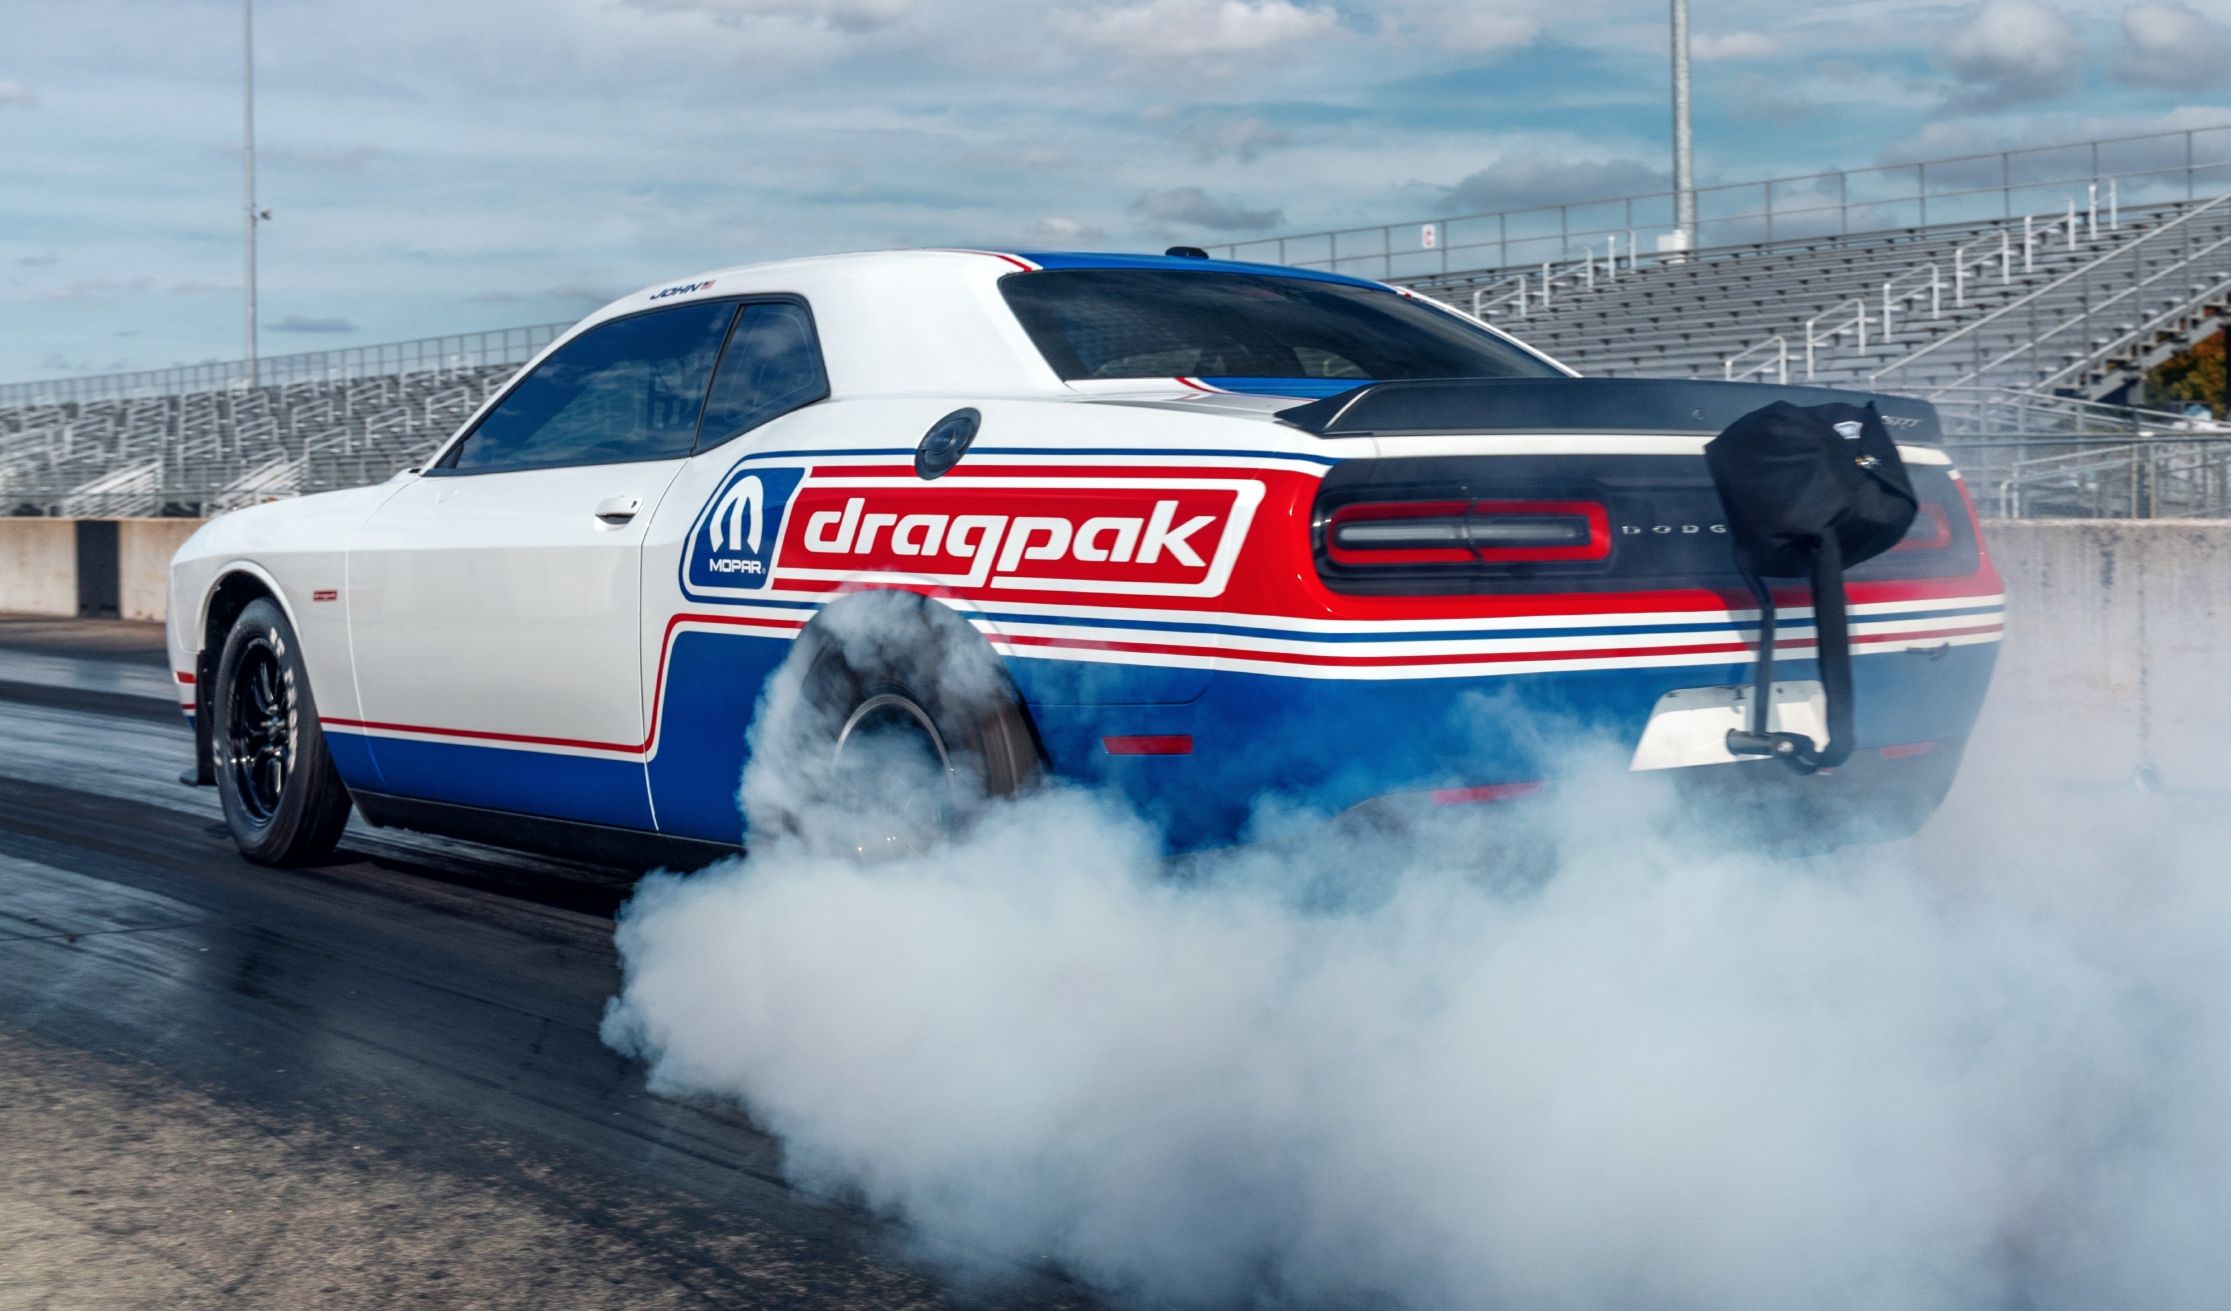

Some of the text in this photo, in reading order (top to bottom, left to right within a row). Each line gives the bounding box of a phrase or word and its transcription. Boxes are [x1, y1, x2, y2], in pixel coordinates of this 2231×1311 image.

[649, 282, 703, 300] JOHN
[1621, 524, 1728, 535] DODG
[804, 497, 1217, 587] dragpak
[709, 558, 762, 575] MOPAR
